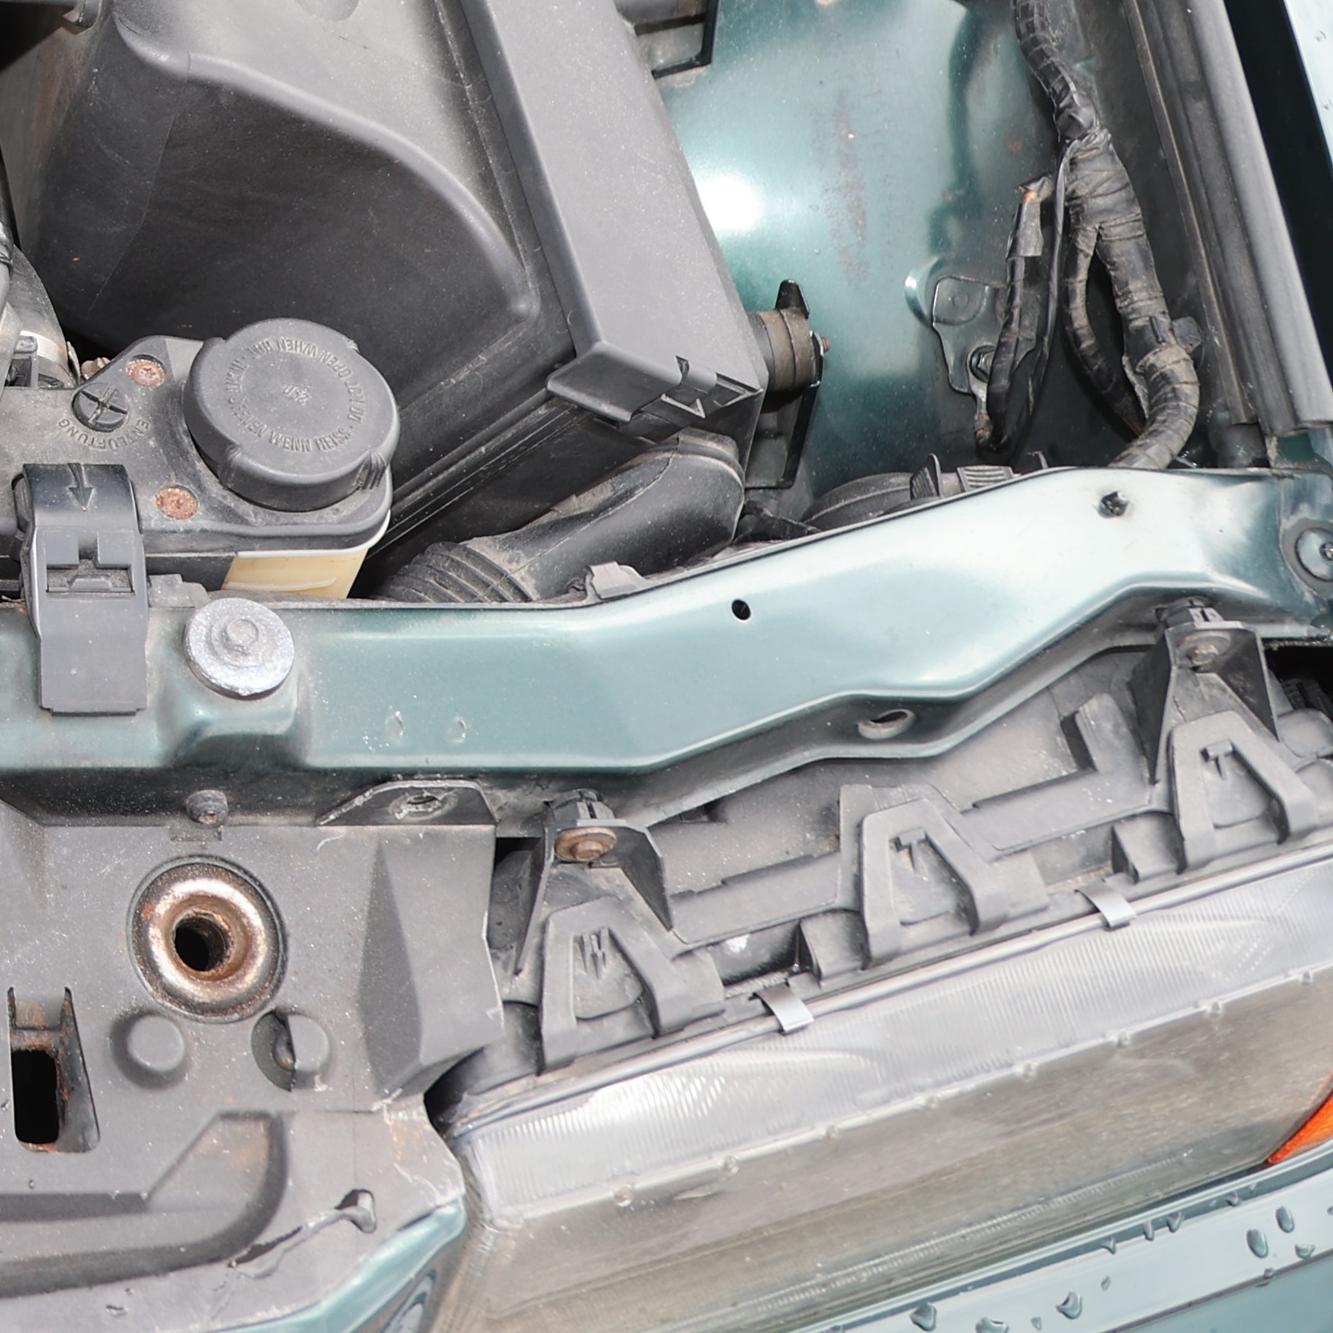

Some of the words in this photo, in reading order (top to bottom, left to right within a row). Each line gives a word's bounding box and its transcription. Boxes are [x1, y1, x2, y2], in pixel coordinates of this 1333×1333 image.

[276, 337, 319, 358] WHEN
[318, 351, 353, 380] OPEN
[268, 429, 313, 453] WENN
[314, 427, 352, 452] HEISS
